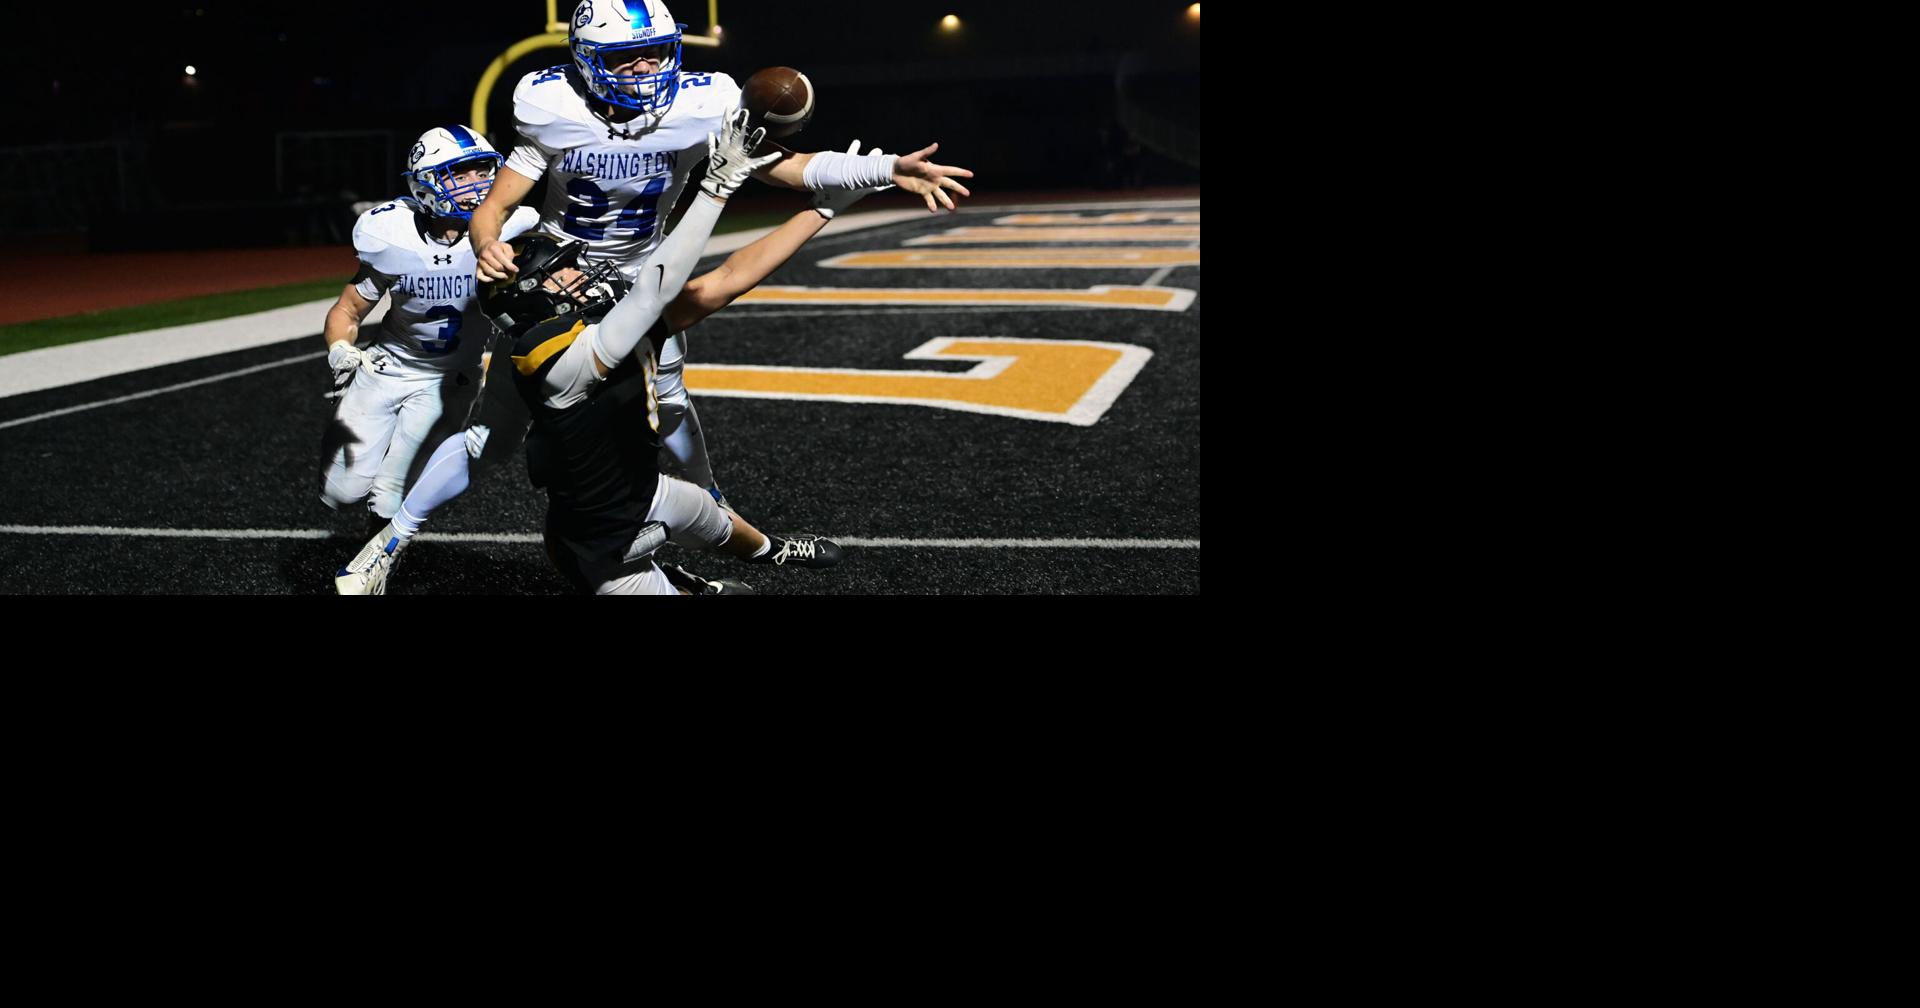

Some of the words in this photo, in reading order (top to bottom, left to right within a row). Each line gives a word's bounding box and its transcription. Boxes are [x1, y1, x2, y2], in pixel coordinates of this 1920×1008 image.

[562, 149, 678, 180] WASHINGTON
[370, 203, 396, 216] 3
[563, 177, 666, 241] 24
[399, 274, 477, 300] WASHINGT
[420, 304, 463, 354] 3
